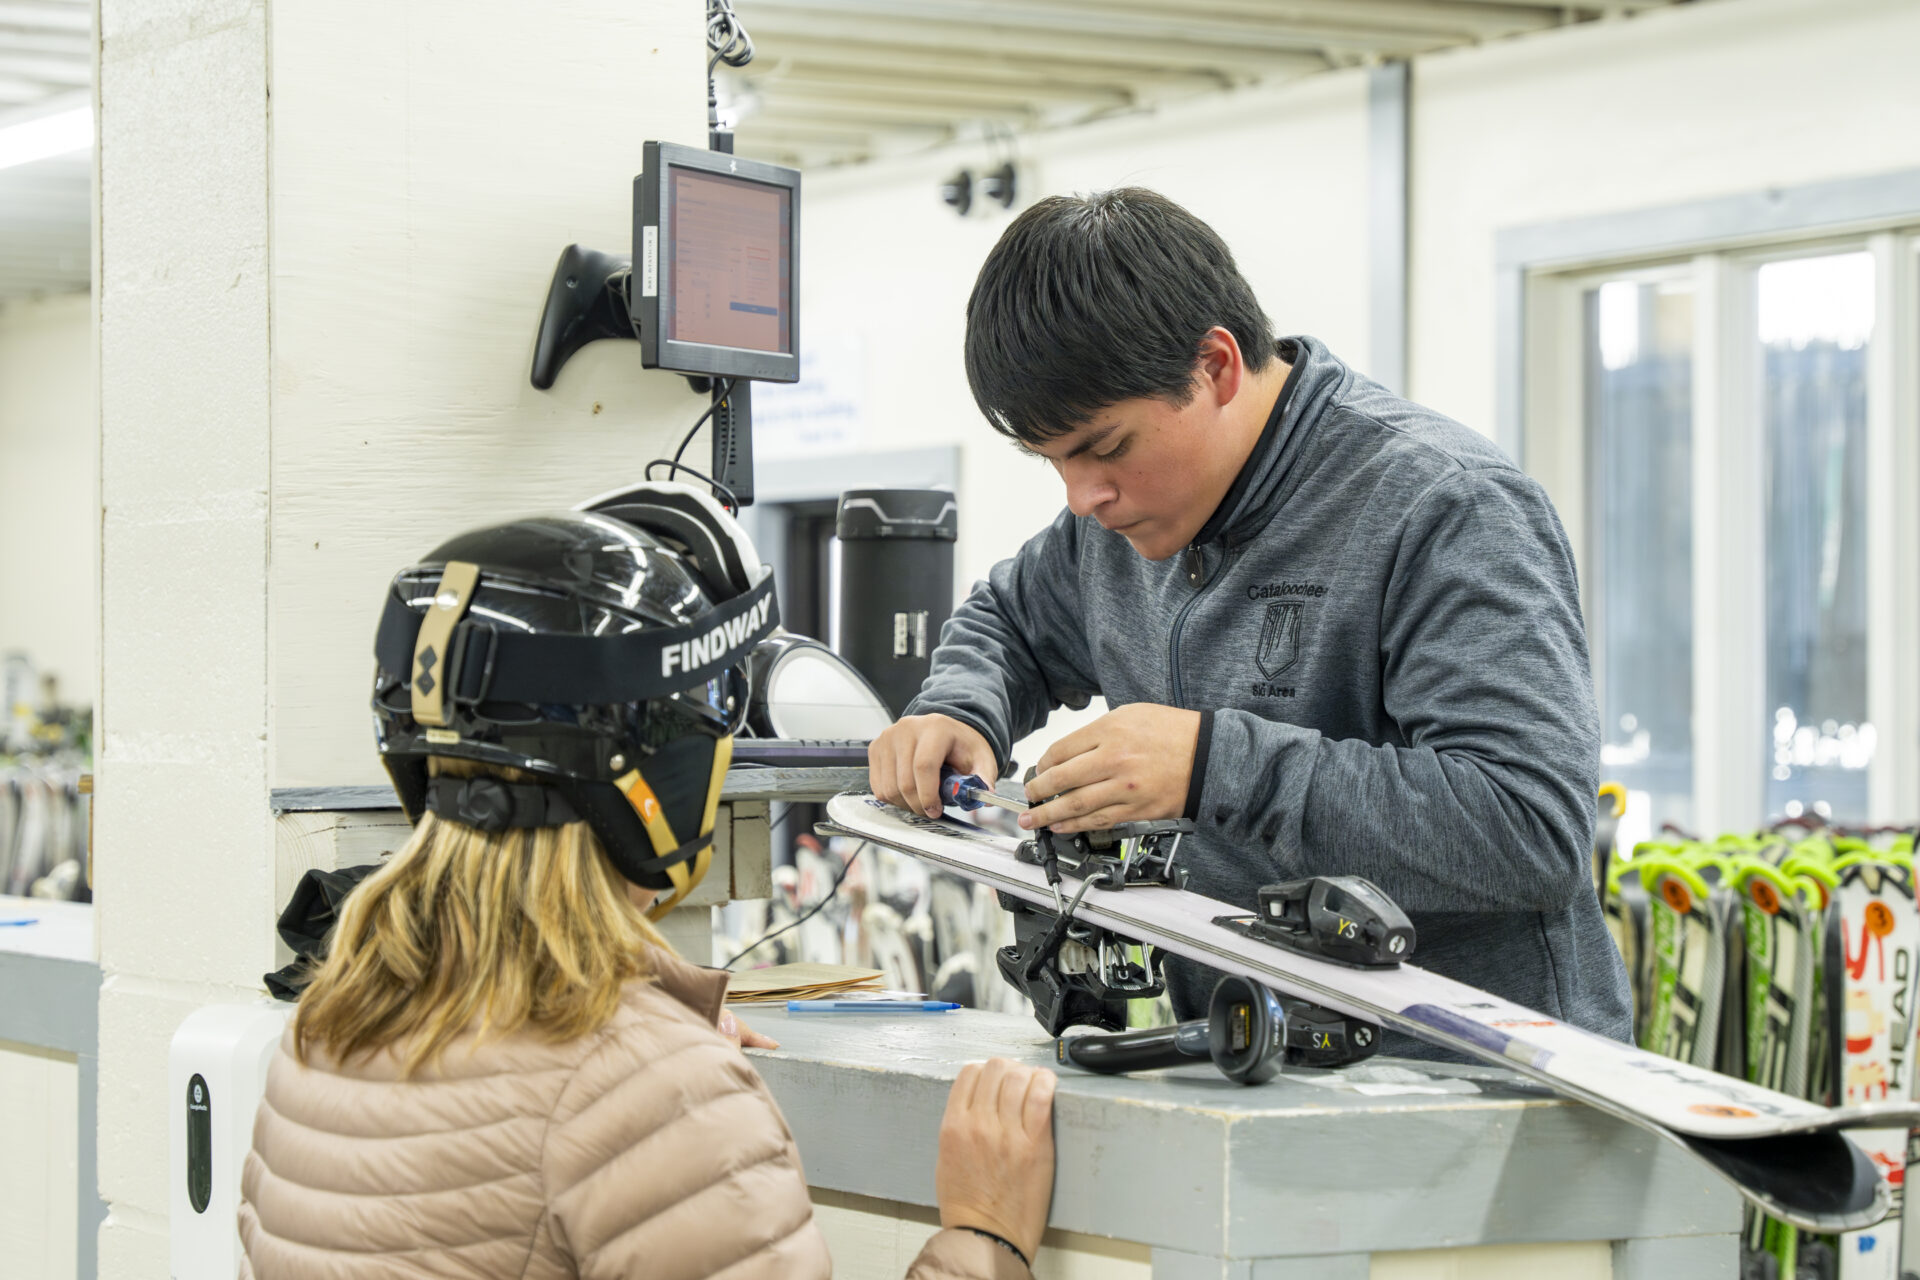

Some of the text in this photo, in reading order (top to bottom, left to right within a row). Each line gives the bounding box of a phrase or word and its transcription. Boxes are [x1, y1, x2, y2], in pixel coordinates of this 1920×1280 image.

[661, 591, 772, 678] FINDWAY
[1268, 684, 1296, 697] Area
[1337, 917, 1359, 939] YS
[1887, 947, 1909, 1090] HEAD
[1312, 1031, 1332, 1049] YS
